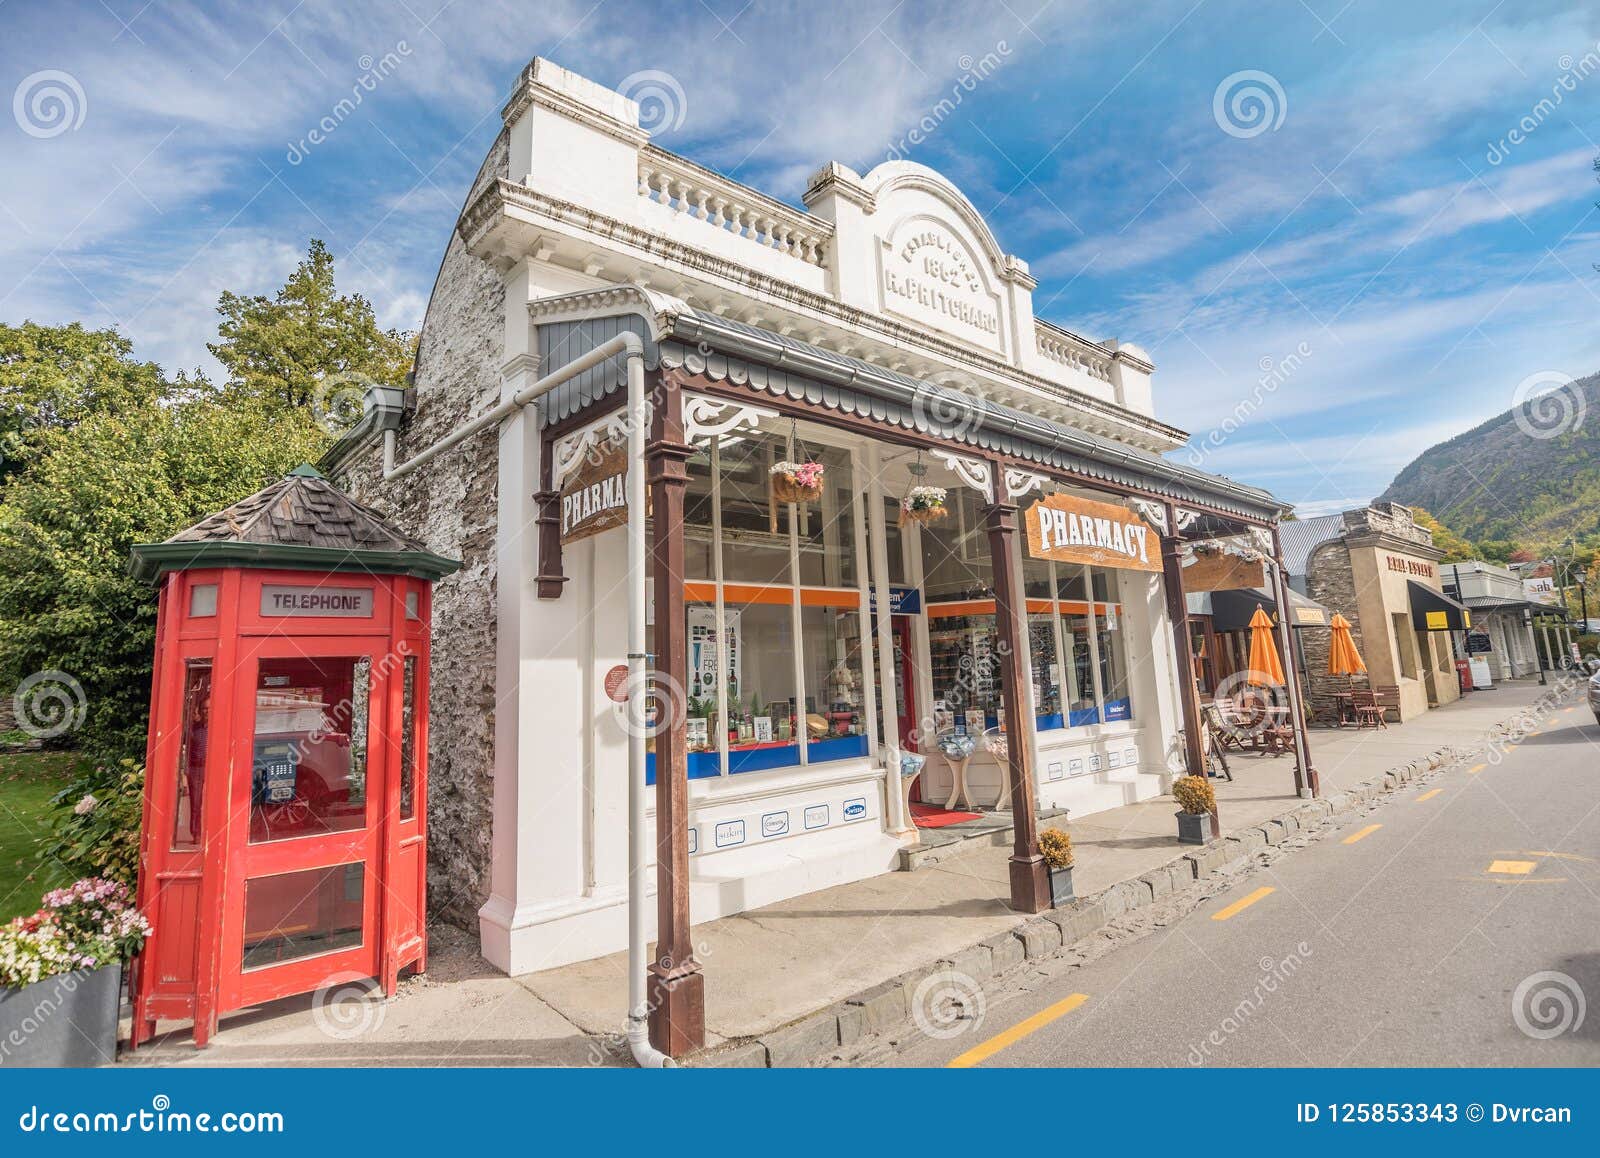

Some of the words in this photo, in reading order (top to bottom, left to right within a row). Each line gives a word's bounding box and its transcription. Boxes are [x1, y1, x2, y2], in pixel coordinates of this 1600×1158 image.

[563, 473, 653, 537] PHARMA
[1037, 505, 1149, 564] PHARMACY
[272, 593, 362, 611] TELEPHONE
[703, 660, 718, 671] FRE
